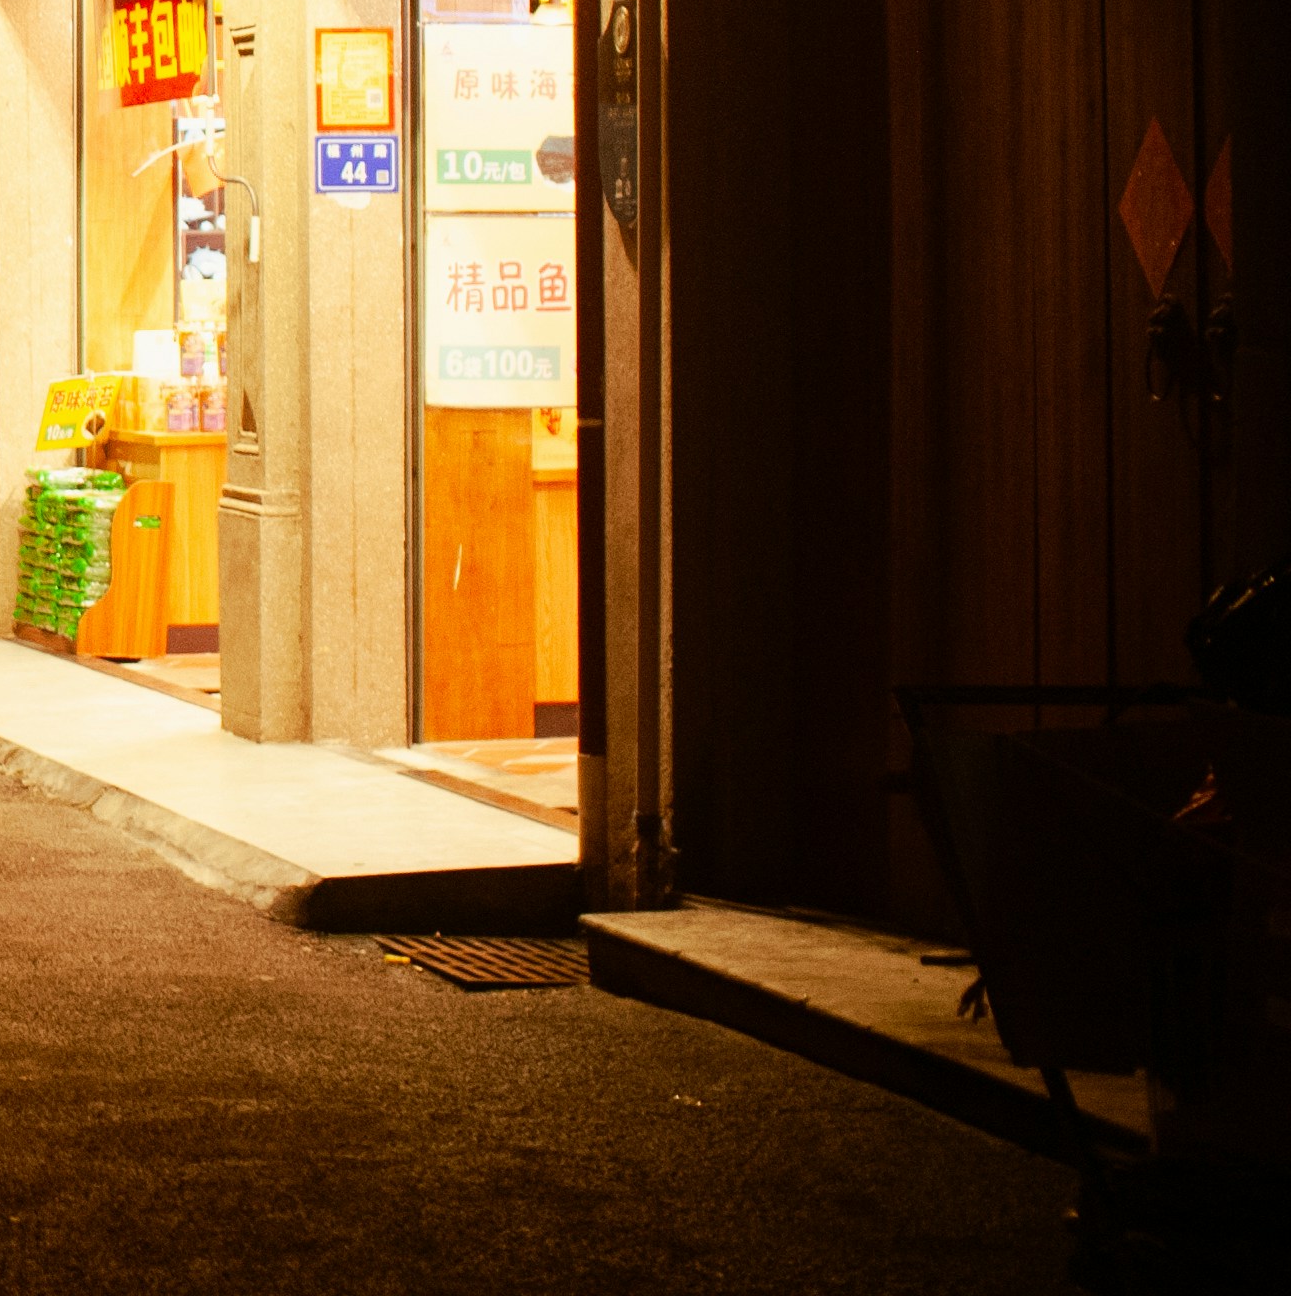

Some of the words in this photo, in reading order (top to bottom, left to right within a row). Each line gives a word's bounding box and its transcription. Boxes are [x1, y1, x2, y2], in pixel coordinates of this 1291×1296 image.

[454, 69, 575, 100] 原味海
[340, 161, 367, 184] 44
[447, 261, 572, 313] 精品鱼
